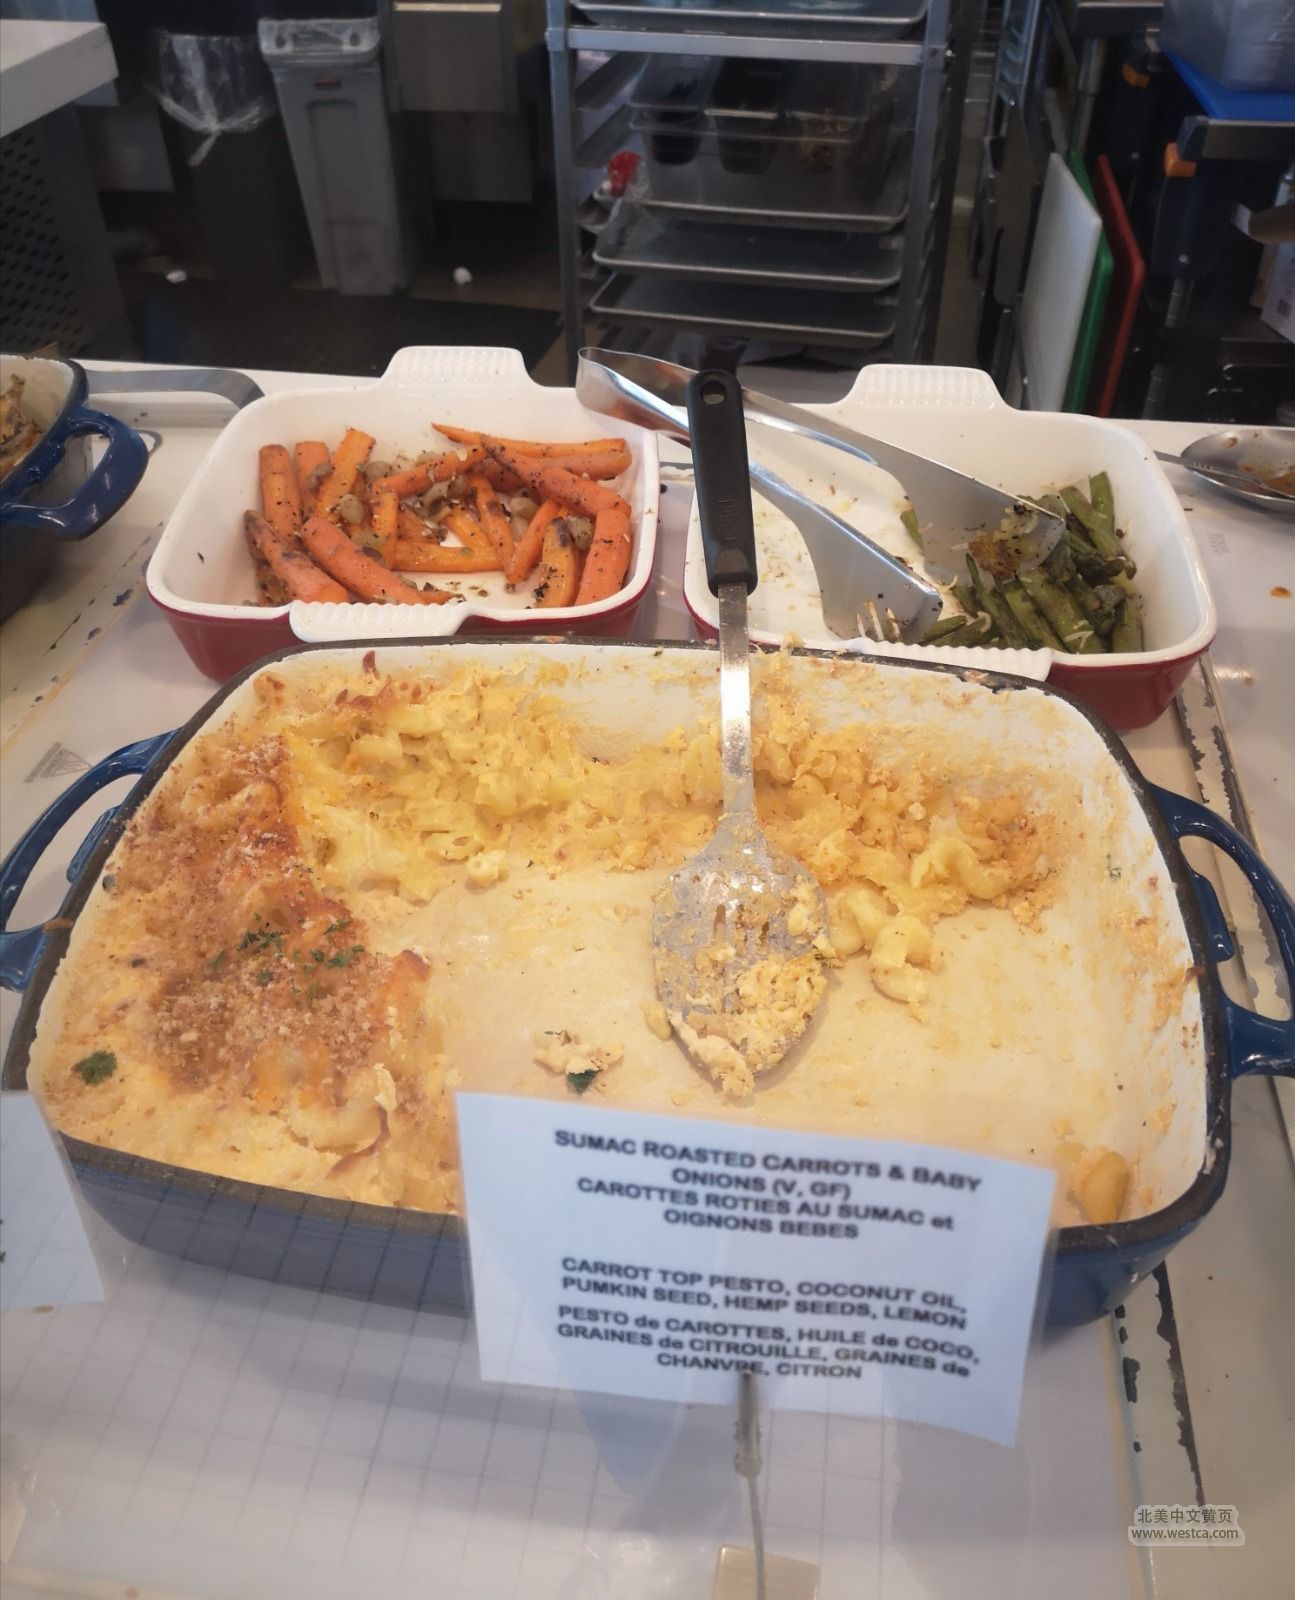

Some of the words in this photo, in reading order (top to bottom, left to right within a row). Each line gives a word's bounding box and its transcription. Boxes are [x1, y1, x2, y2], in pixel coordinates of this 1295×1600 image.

[555, 1130, 636, 1155] SUMAC
[643, 1140, 756, 1168] ROASTED
[762, 1153, 881, 1178] CARROTS
[888, 1165, 905, 1180] &
[913, 1167, 982, 1192] BABY
[672, 1168, 766, 1192] ONIONS
[773, 1178, 803, 1197] (V,
[810, 1181, 851, 1200] GF)
[578, 1177, 699, 1205] CAROTTES
[705, 1193, 790, 1214] ROTIES
[797, 1202, 831, 1217] AU
[838, 1203, 924, 1225] SUMAC
[931, 1216, 954, 1230] et
[664, 1209, 772, 1233] OIGNONS
[780, 1221, 858, 1238] BEBES
[562, 1257, 652, 1281] CARROT
[658, 1268, 703, 1286] TOP
[709, 1275, 791, 1296] PESTO,
[797, 1282, 915, 1301] COCONUT
[562, 1277, 647, 1299] PUMKIN
[653, 1287, 718, 1308] SEED,
[724, 1296, 788, 1312] HEMP
[795, 1300, 876, 1319] SEEDS,
[884, 1306, 967, 1330] LEMON
[557, 1323, 653, 1346] GRAINES
[658, 1336, 684, 1349] de
[689, 1338, 828, 1361] CITROUILLE,
[835, 1348, 936, 1370] GRAINES
[942, 1361, 970, 1377] de
[558, 1305, 629, 1325] PESTO
[635, 1316, 659, 1330] de
[665, 1318, 792, 1342] CAROTTES,
[798, 1328, 865, 1344] HUILE
[871, 1333, 899, 1347] de
[905, 1335, 980, 1364] COCO,
[776, 1362, 862, 1379] CITRON
